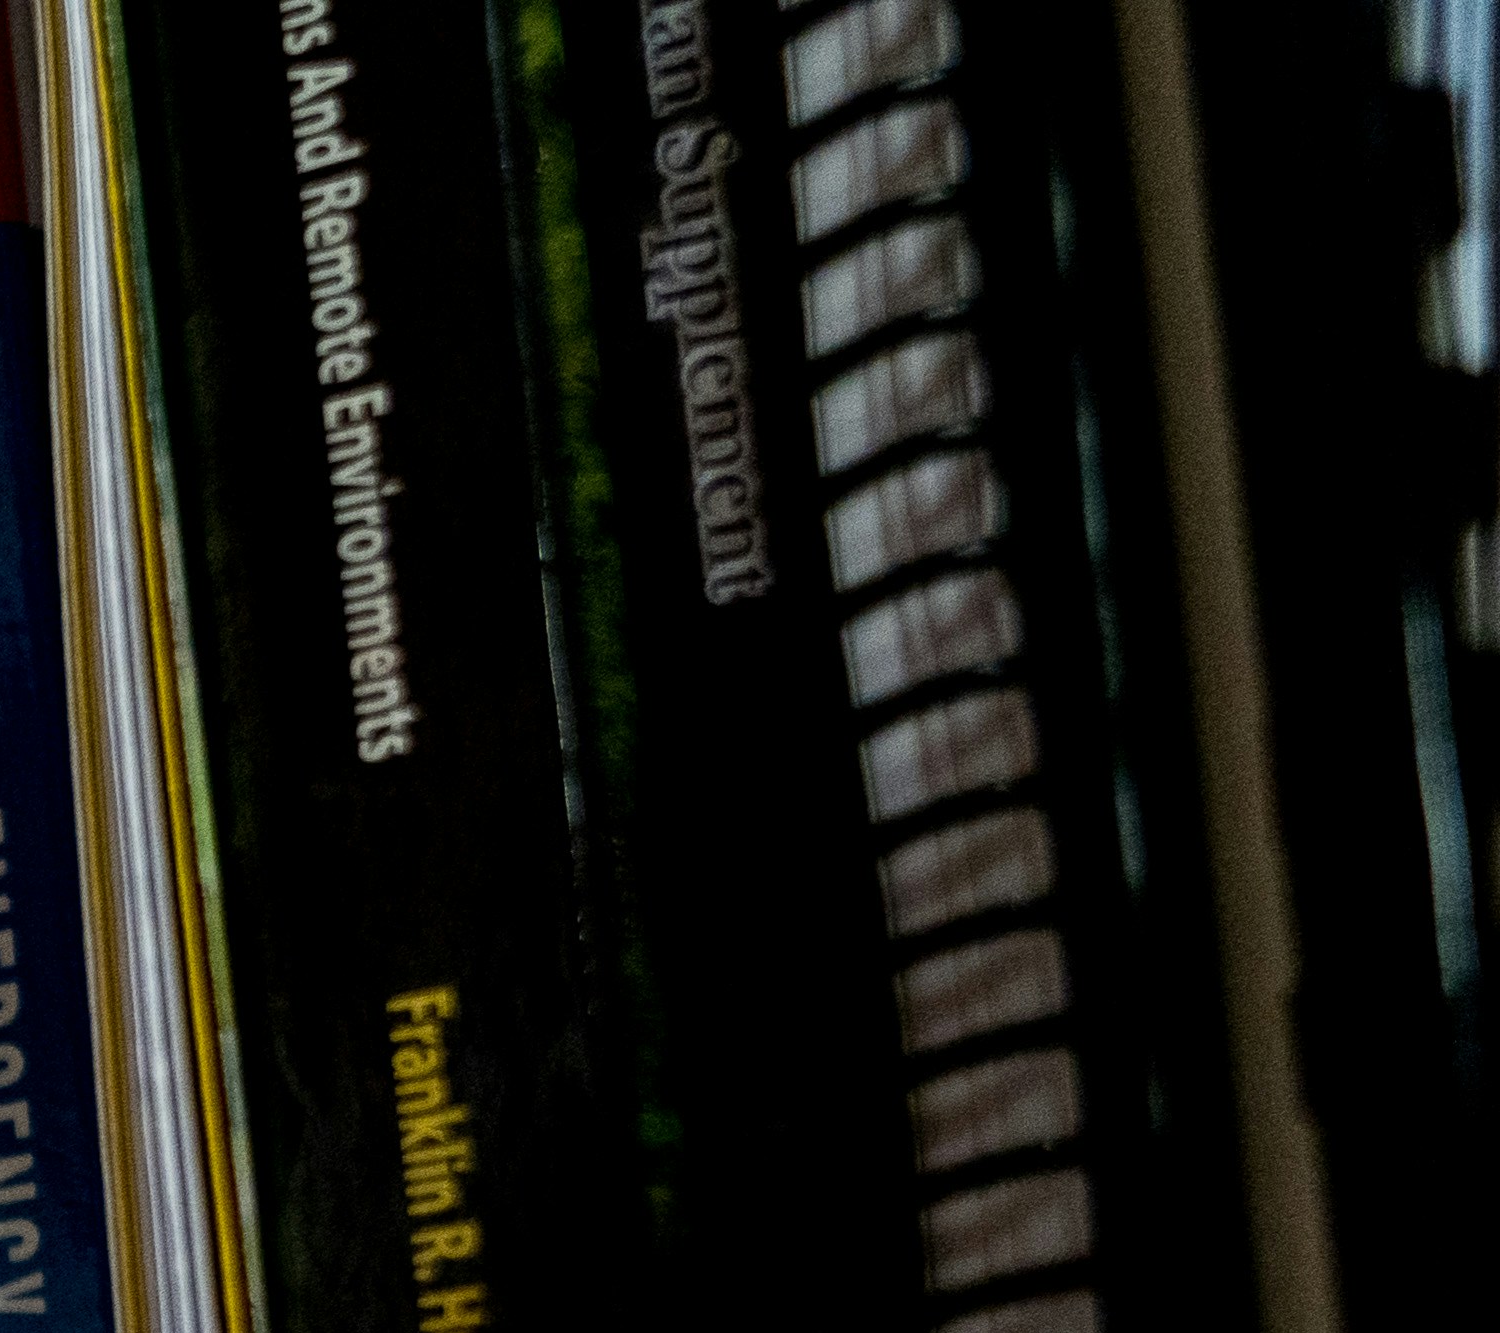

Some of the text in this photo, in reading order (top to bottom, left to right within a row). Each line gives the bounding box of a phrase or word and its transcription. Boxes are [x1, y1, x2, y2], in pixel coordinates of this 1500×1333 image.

[286, 60, 366, 174] And
[299, 170, 376, 386] Remote
[640, 118, 775, 605] Supplement
[320, 383, 418, 764] Environments
[386, 984, 472, 1218] Franklin
[410, 1221, 481, 1283] R.
